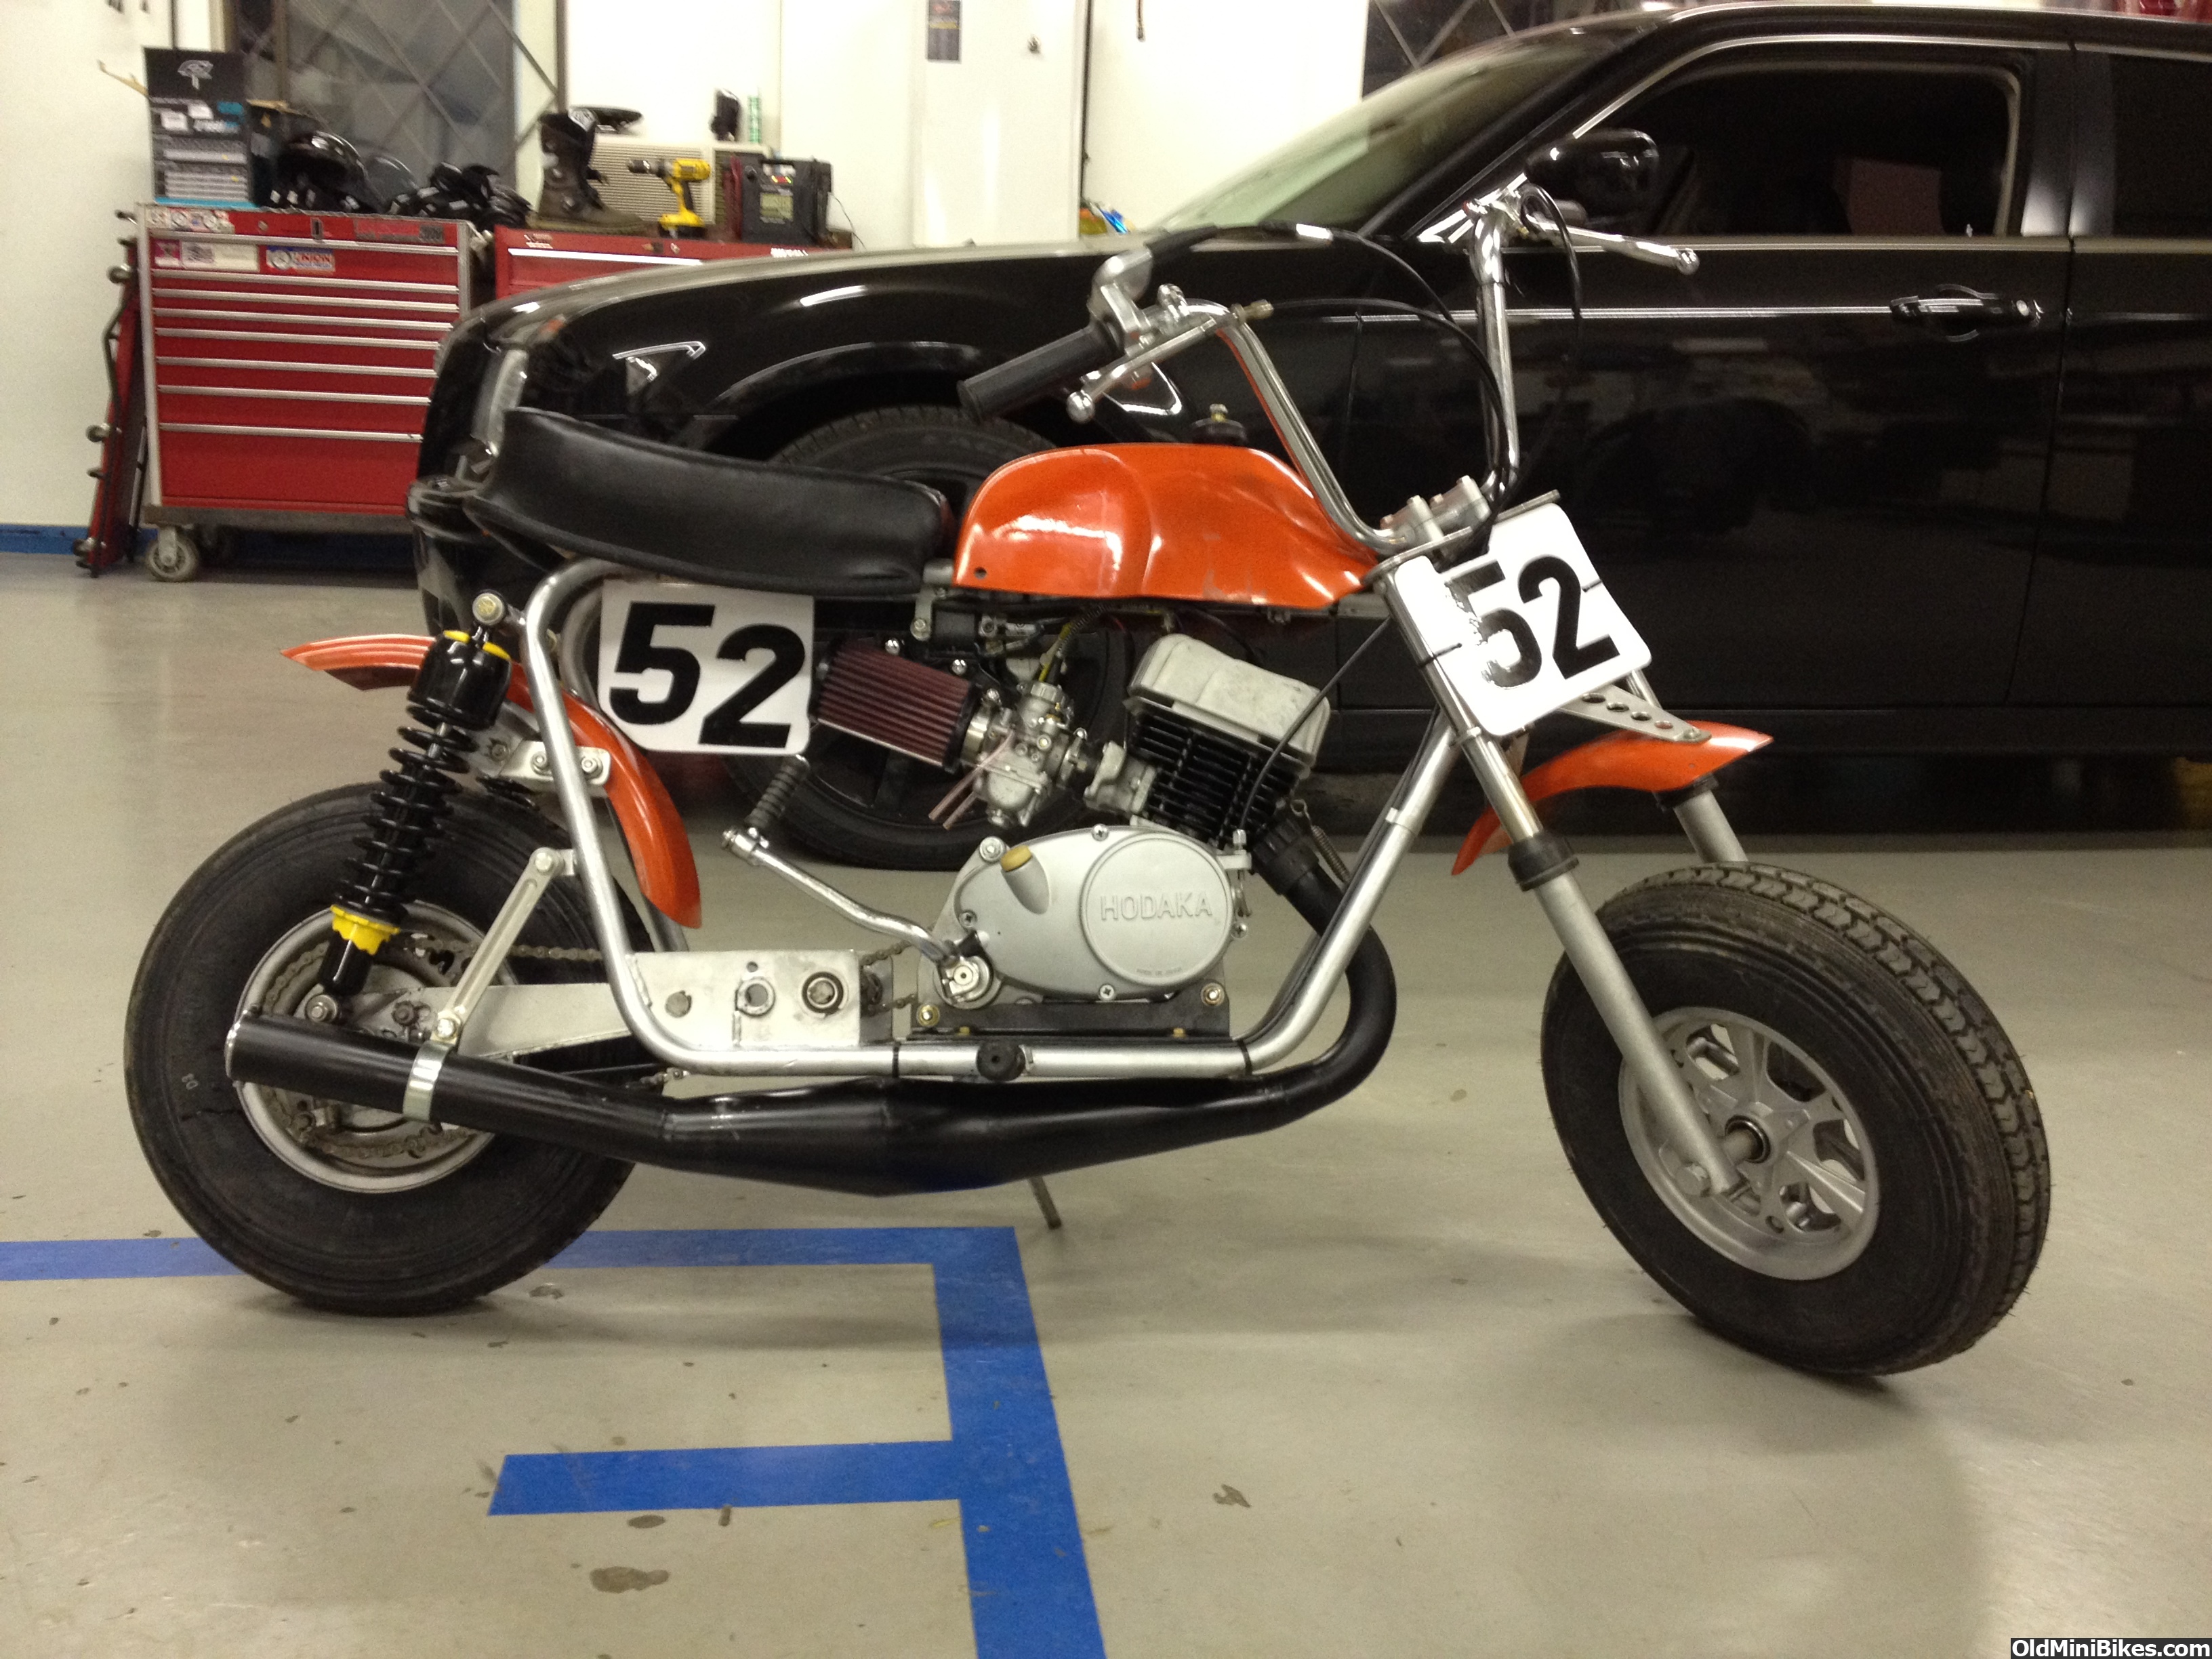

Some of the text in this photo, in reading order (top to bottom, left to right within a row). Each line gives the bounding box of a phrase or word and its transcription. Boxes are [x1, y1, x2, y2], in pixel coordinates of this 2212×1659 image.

[609, 601, 806, 748] 52
[1444, 554, 1620, 690] 52
[1100, 892, 1212, 921] HODAKA
